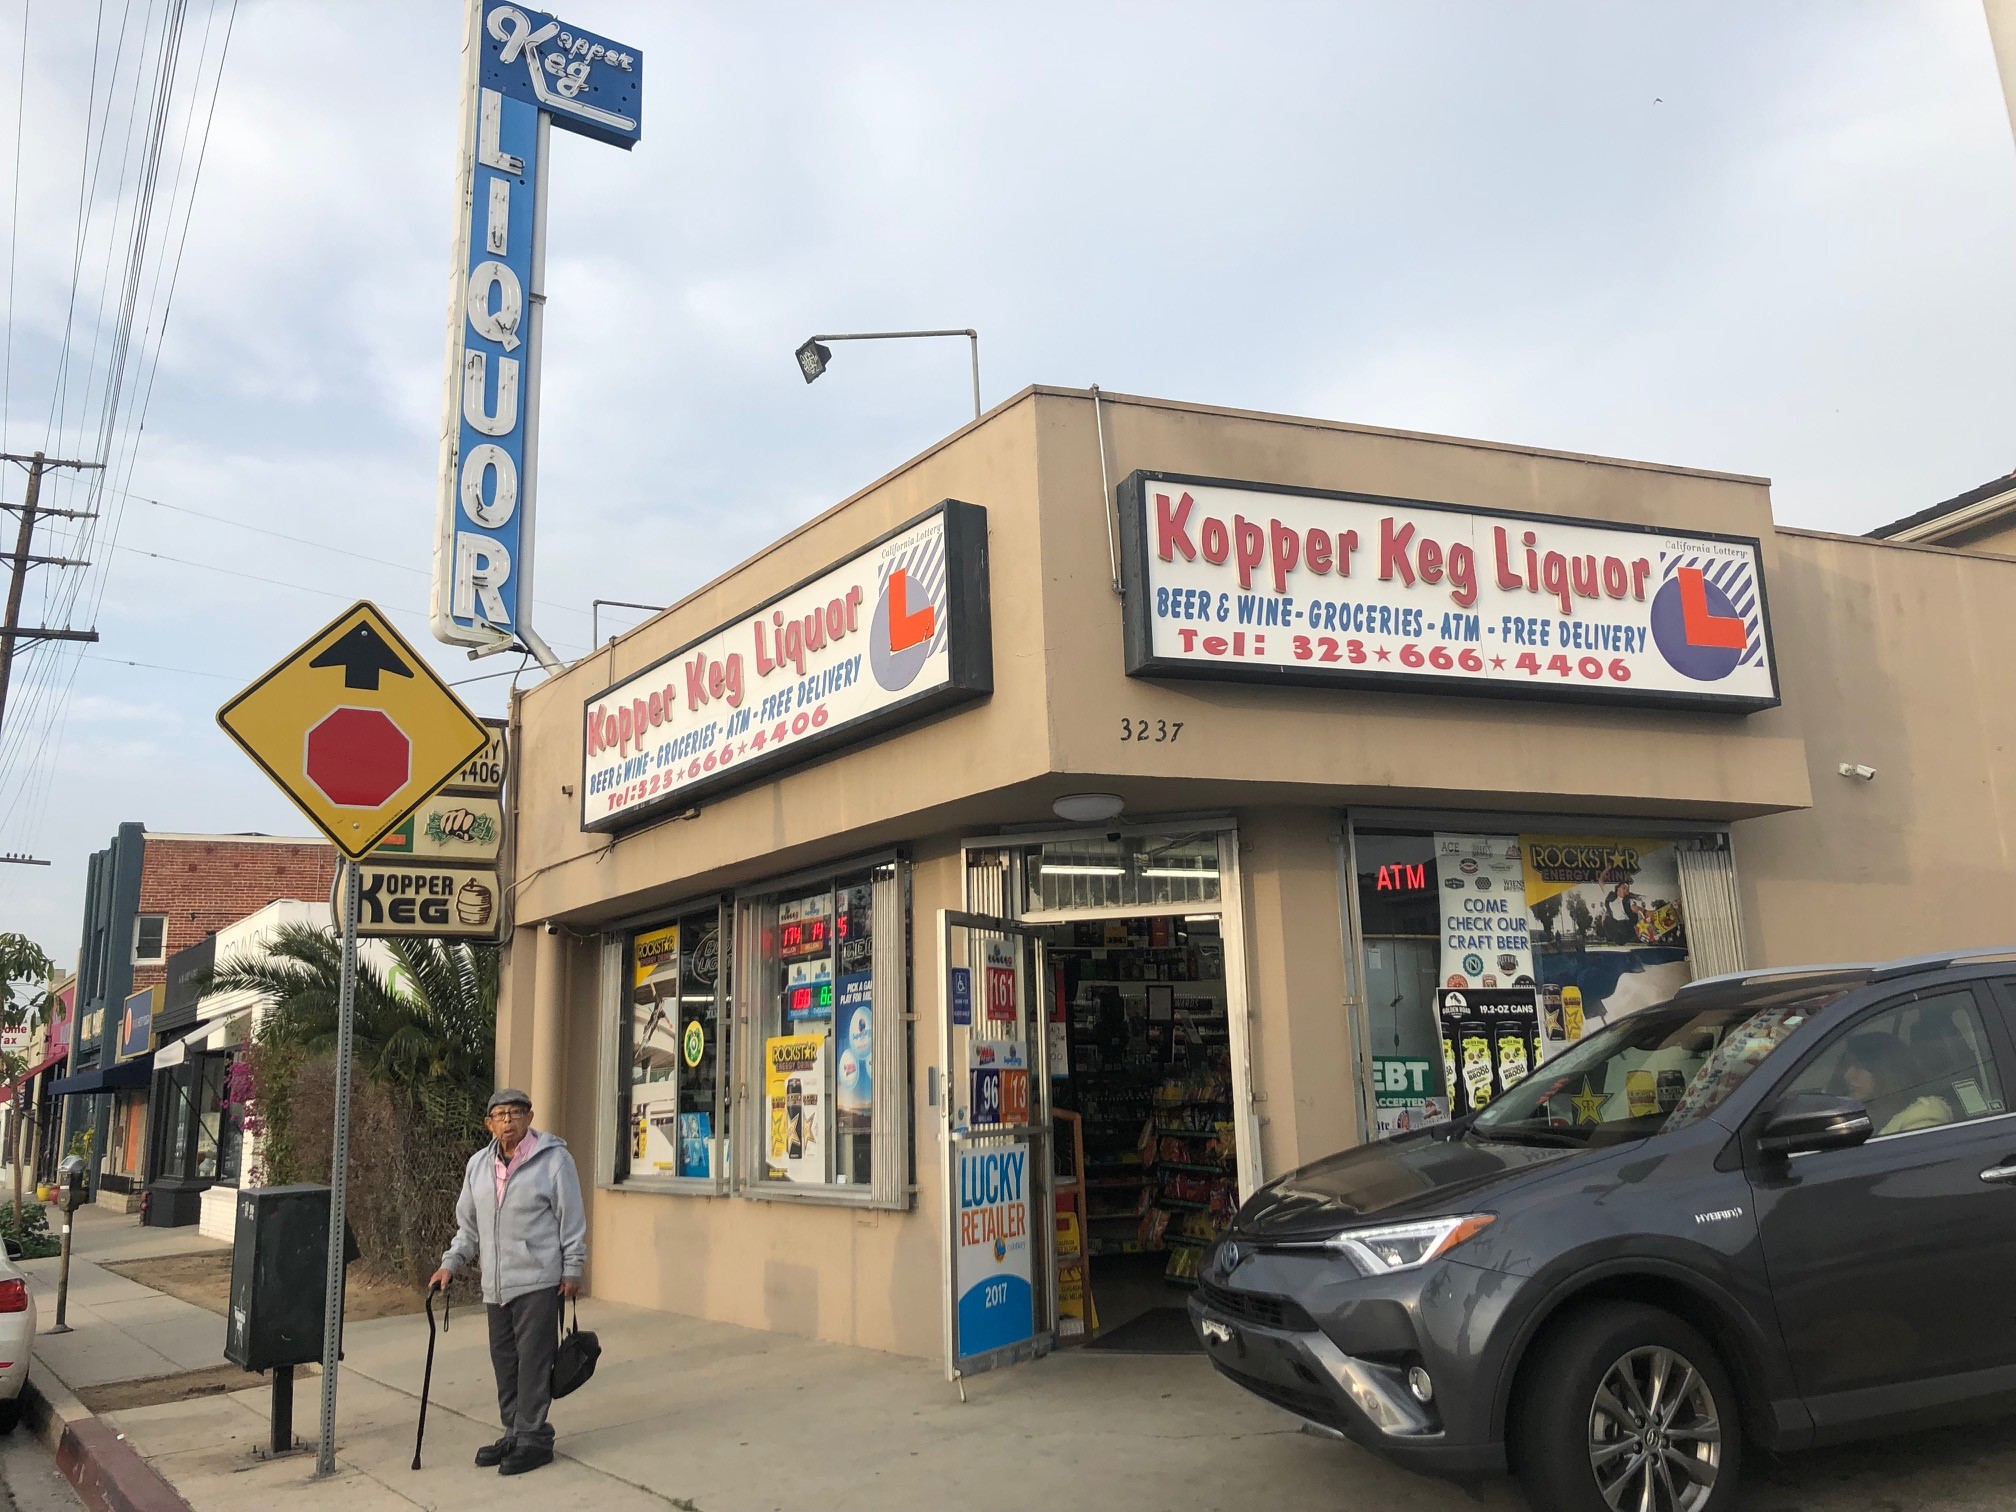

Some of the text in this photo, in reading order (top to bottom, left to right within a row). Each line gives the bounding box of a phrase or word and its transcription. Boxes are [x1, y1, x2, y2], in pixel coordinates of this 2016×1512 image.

[453, 87, 525, 624] LIQUOR
[882, 523, 942, 559] California Lottery
[1665, 540, 1748, 560] California Lottery
[1154, 492, 1651, 615] Kopper Keg Liquor
[1157, 586, 1211, 622] BEER
[1216, 593, 1230, 622] &
[1559, 621, 1647, 654] DELIVERY
[588, 585, 863, 758] Kopper Keg Liquor
[589, 771, 614, 795] BEER
[797, 654, 862, 708] DELIVERY
[1120, 717, 1184, 743] 3237
[1441, 842, 1460, 853] ACE
[1377, 864, 1426, 891] ATM
[1543, 869, 1589, 883] ENERGY
[1464, 898, 1509, 914] COME
[1447, 916, 1528, 932] CHECK OUR
[1448, 935, 1530, 950] CRAFT BEER
[1480, 1004, 1534, 1014] 19.2-OZ CANS
[2, 1025, 28, 1034] ome
[2, 1037, 17, 1045] ax
[1468, 1069, 1490, 1081] BROOD
[1504, 1068, 1526, 1081] BROOD
[961, 1151, 1025, 1209] LUCKY
[961, 1202, 1026, 1247] RETAILER
[1695, 1206, 1743, 1224] HYBRID
[985, 1282, 1008, 1310] 2017
